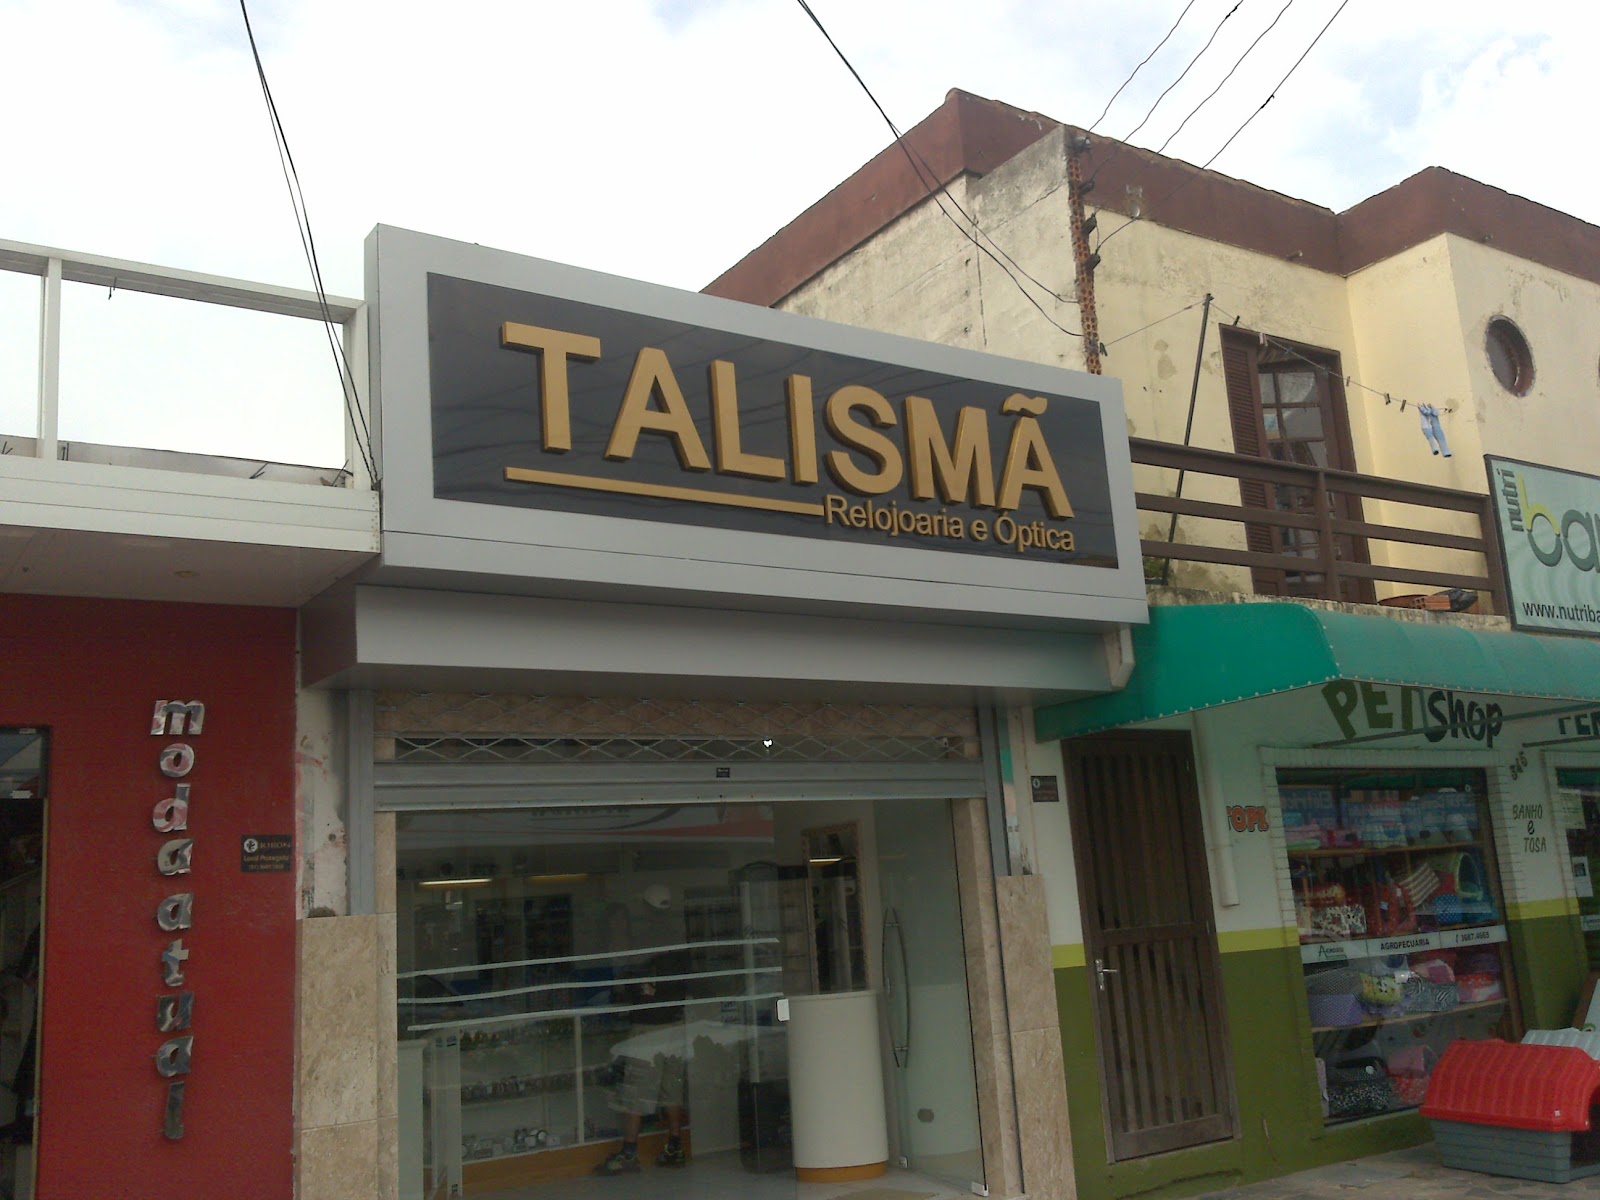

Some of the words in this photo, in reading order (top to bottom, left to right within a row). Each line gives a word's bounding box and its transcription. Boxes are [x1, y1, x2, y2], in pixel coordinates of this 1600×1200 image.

[501, 320, 1074, 520] TALISMÃ
[824, 493, 964, 539] Relojoaria
[970, 519, 989, 542] e
[994, 511, 1075, 552] Óptica
[1516, 470, 1600, 574] ba
[149, 699, 206, 876] moda
[1512, 803, 1543, 820] BANHO
[1523, 837, 1547, 853] TOSA
[1527, 820, 1535, 835] e
